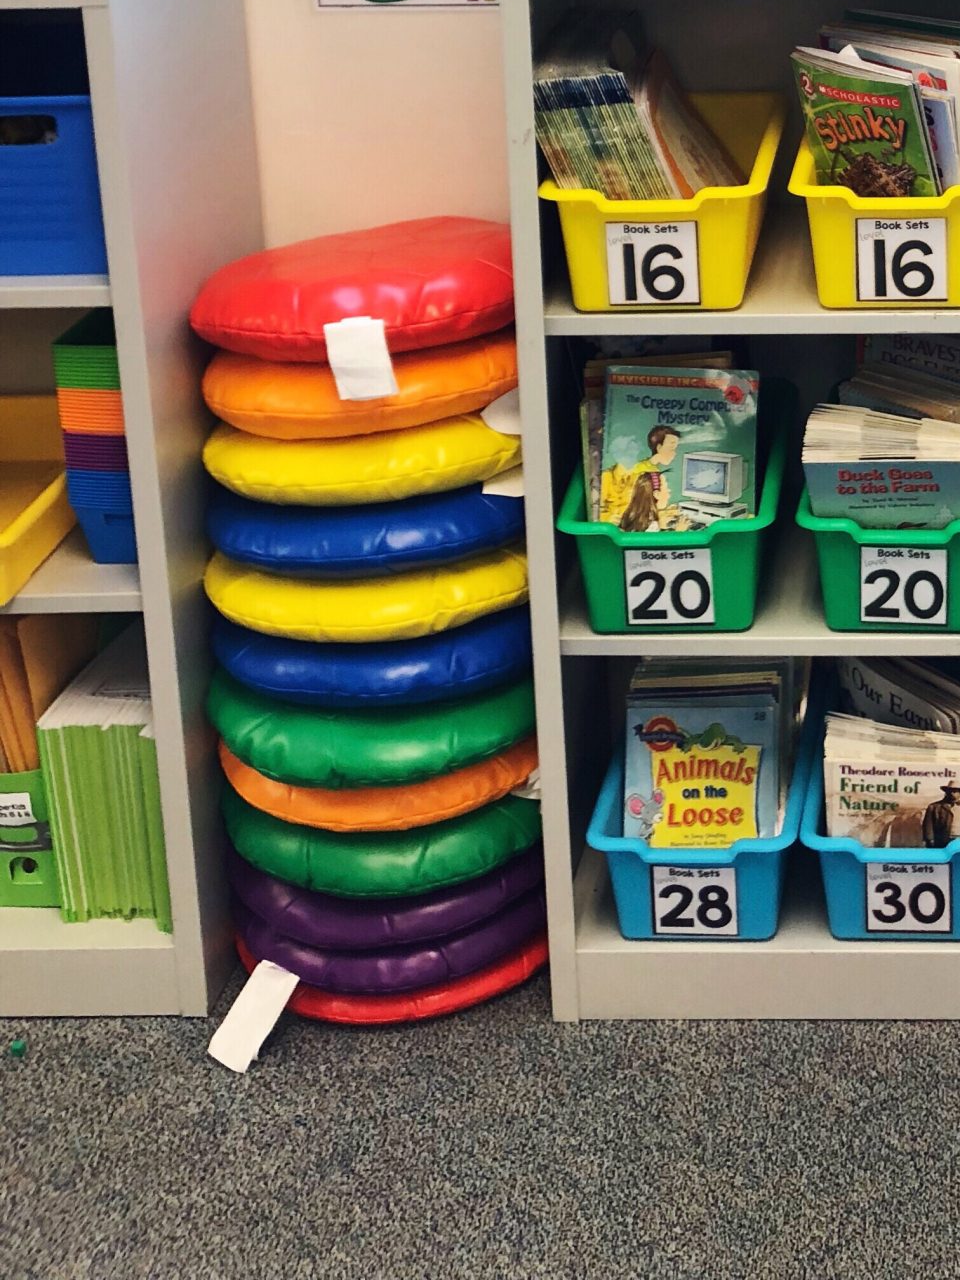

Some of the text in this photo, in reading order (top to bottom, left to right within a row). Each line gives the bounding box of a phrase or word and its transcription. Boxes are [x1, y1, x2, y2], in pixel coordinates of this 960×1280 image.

[801, 74, 900, 108] 2 SCHOLASTIC
[814, 106, 906, 151] Stinky
[623, 223, 679, 234] Book Sets
[875, 220, 930, 231] Book Sets
[622, 242, 685, 301] 16
[873, 239, 935, 297] 16
[626, 394, 686, 412] The Creepy
[657, 411, 710, 426] Mystery
[837, 468, 935, 482] Duck Goes
[836, 480, 941, 495] to the Farm
[641, 550, 695, 561] Book Sets
[877, 549, 931, 560] Book Sets
[630, 570, 711, 620] 20
[864, 568, 944, 619] 20
[851, 666, 883, 705] Our
[656, 755, 756, 786] Animals
[839, 764, 957, 779] Theodore Roosevelt:
[682, 784, 728, 799] on the
[839, 777, 922, 795] Friend of
[839, 795, 900, 812] Nature
[667, 803, 744, 828] Loose
[669, 868, 720, 878] Book Sets
[882, 864, 934, 873] Book Sets
[658, 884, 733, 929] 28
[872, 881, 946, 924] 30
